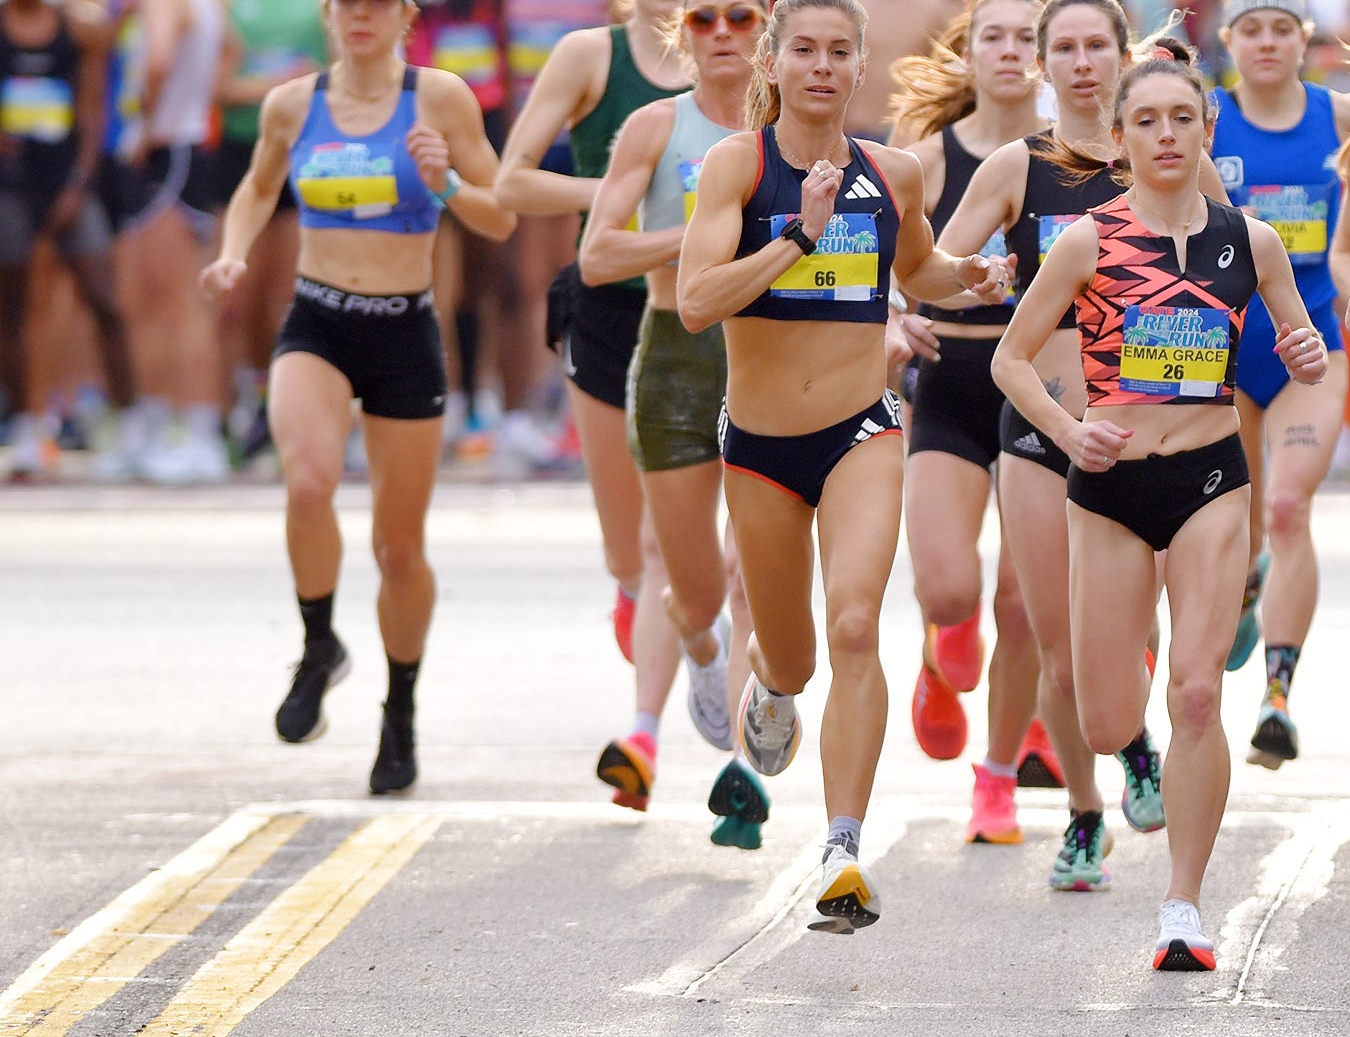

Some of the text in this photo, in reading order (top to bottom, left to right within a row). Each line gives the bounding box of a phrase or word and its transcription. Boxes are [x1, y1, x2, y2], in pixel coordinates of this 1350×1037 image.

[817, 237, 854, 254] RUN
[815, 271, 836, 286] 66
[342, 294, 409, 315] PRO
[1177, 308, 1199, 316] 2024
[1143, 314, 1203, 332] RIVER
[1169, 332, 1206, 348] RUN
[1123, 346, 1224, 362] EMMA GRACE
[1163, 364, 1184, 379] 26
[1014, 440, 1046, 453] adidas
